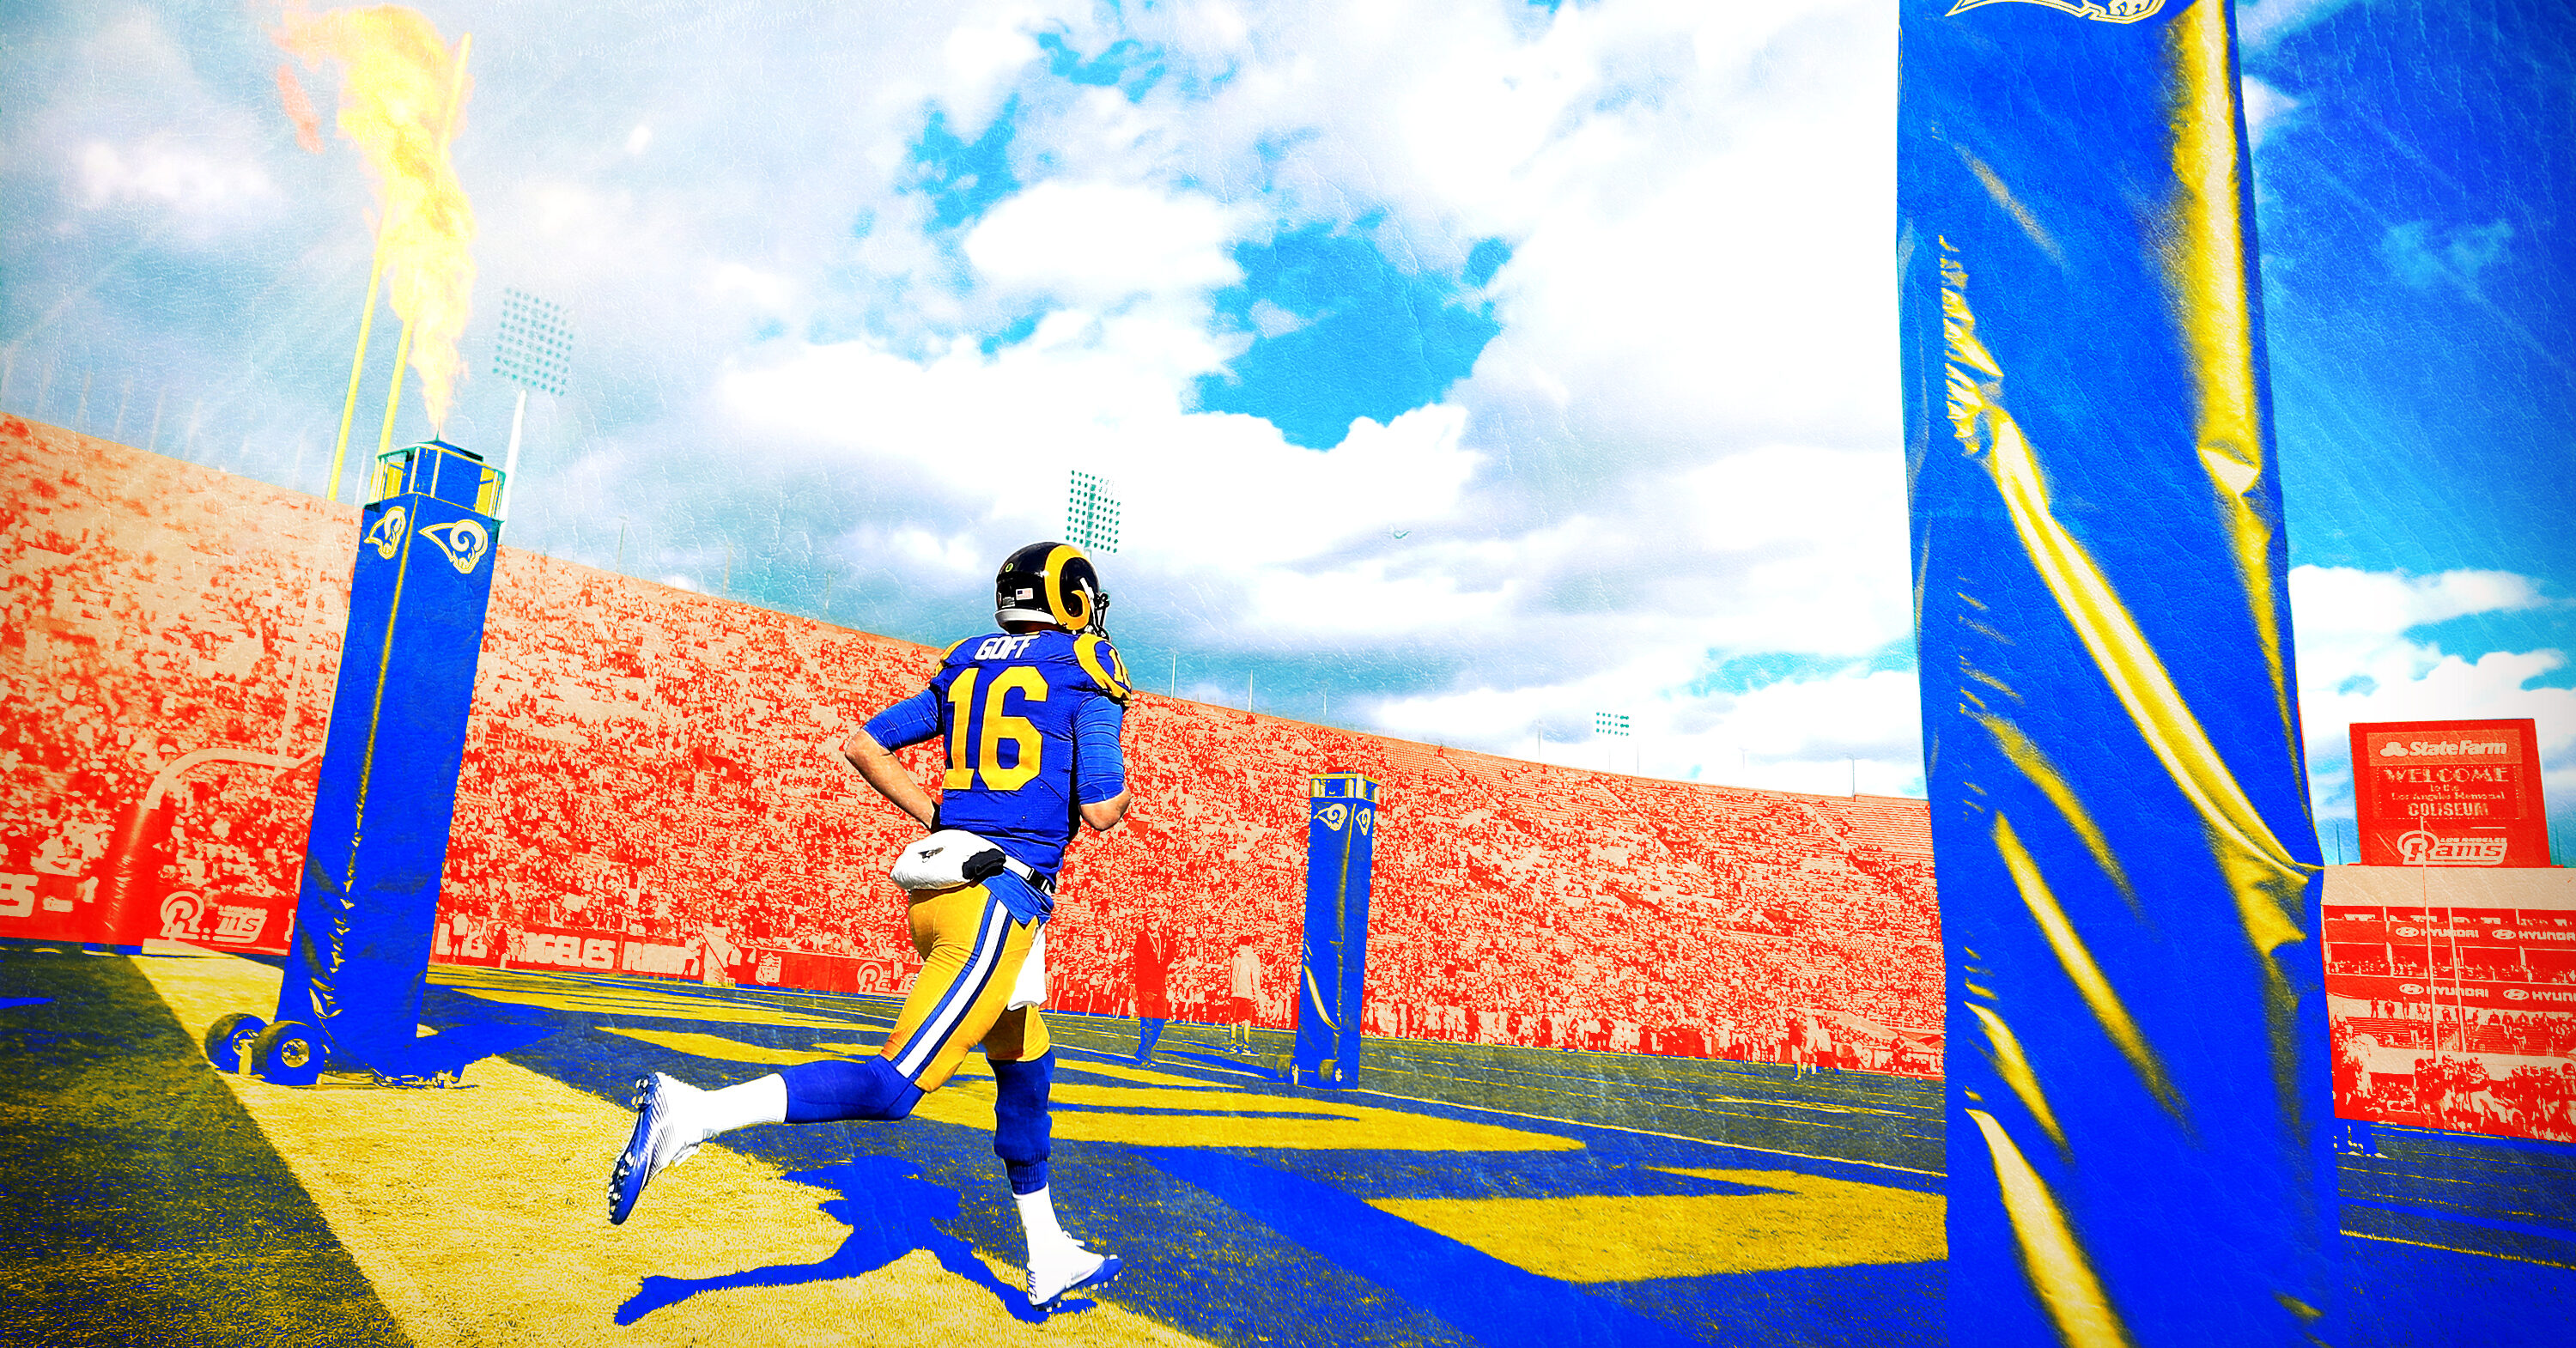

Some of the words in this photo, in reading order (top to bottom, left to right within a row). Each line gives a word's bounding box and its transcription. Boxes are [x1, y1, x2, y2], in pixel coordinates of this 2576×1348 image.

[974, 635, 1041, 660] GOFF
[944, 665, 1049, 792] 16
[2384, 767, 2510, 783] WELCOME
[2407, 802, 2489, 817] COLISEUM
